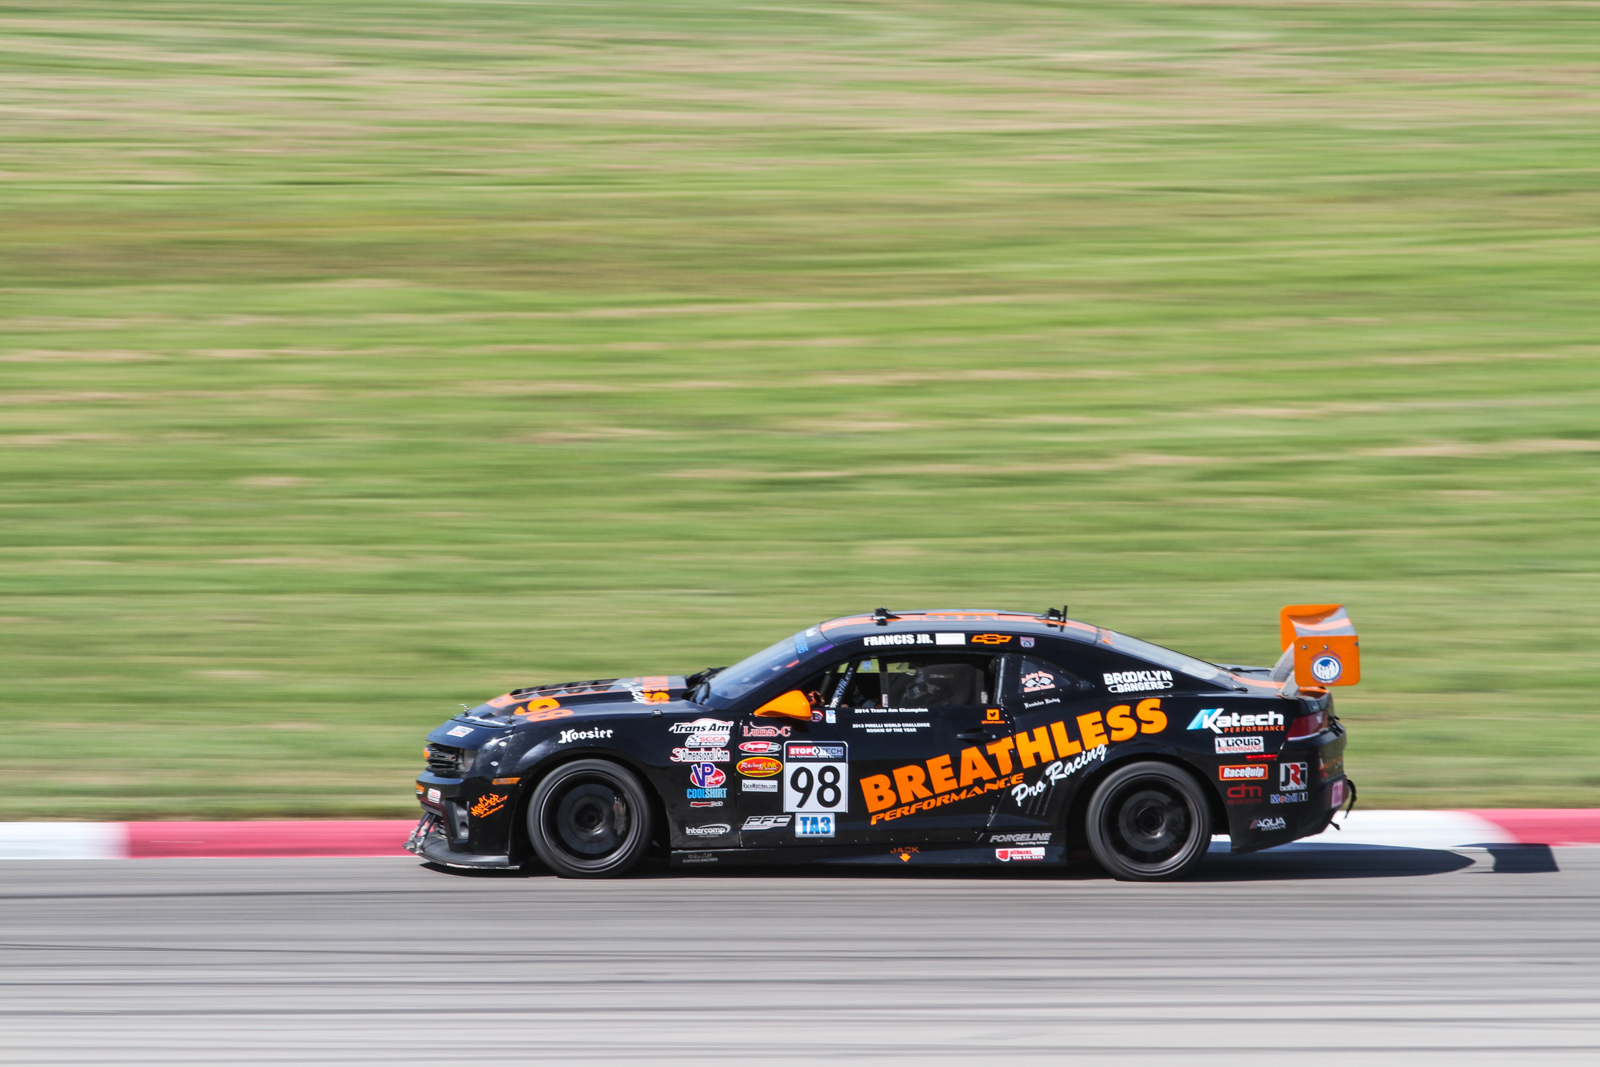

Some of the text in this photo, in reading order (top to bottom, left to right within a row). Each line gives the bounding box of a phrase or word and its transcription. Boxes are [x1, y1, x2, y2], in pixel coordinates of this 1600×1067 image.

[863, 633, 934, 646] FRANCIS JR.
[1102, 670, 1174, 685] BROOKLYN
[1116, 681, 1165, 693] BANGERS
[1202, 708, 1285, 734] Katech
[674, 722, 730, 733] Trans Am
[1223, 725, 1285, 734] PERFORMANCE
[557, 727, 614, 744] Hoosier
[859, 698, 1168, 814] BREATHLESS
[691, 763, 715, 787] VP
[1011, 743, 1108, 807] Pro Racing
[1223, 766, 1265, 778] RaceQuip
[789, 765, 842, 809] 98
[870, 773, 1025, 825] PERFORMANCE
[1270, 793, 1299, 804] Mobil
[745, 816, 791, 826] PFC
[800, 816, 831, 834] TA3
[1256, 817, 1287, 827] AQUA
[685, 826, 727, 835] Intercomp
[989, 833, 1052, 843] FORGELINE
[890, 846, 920, 854] JACK
